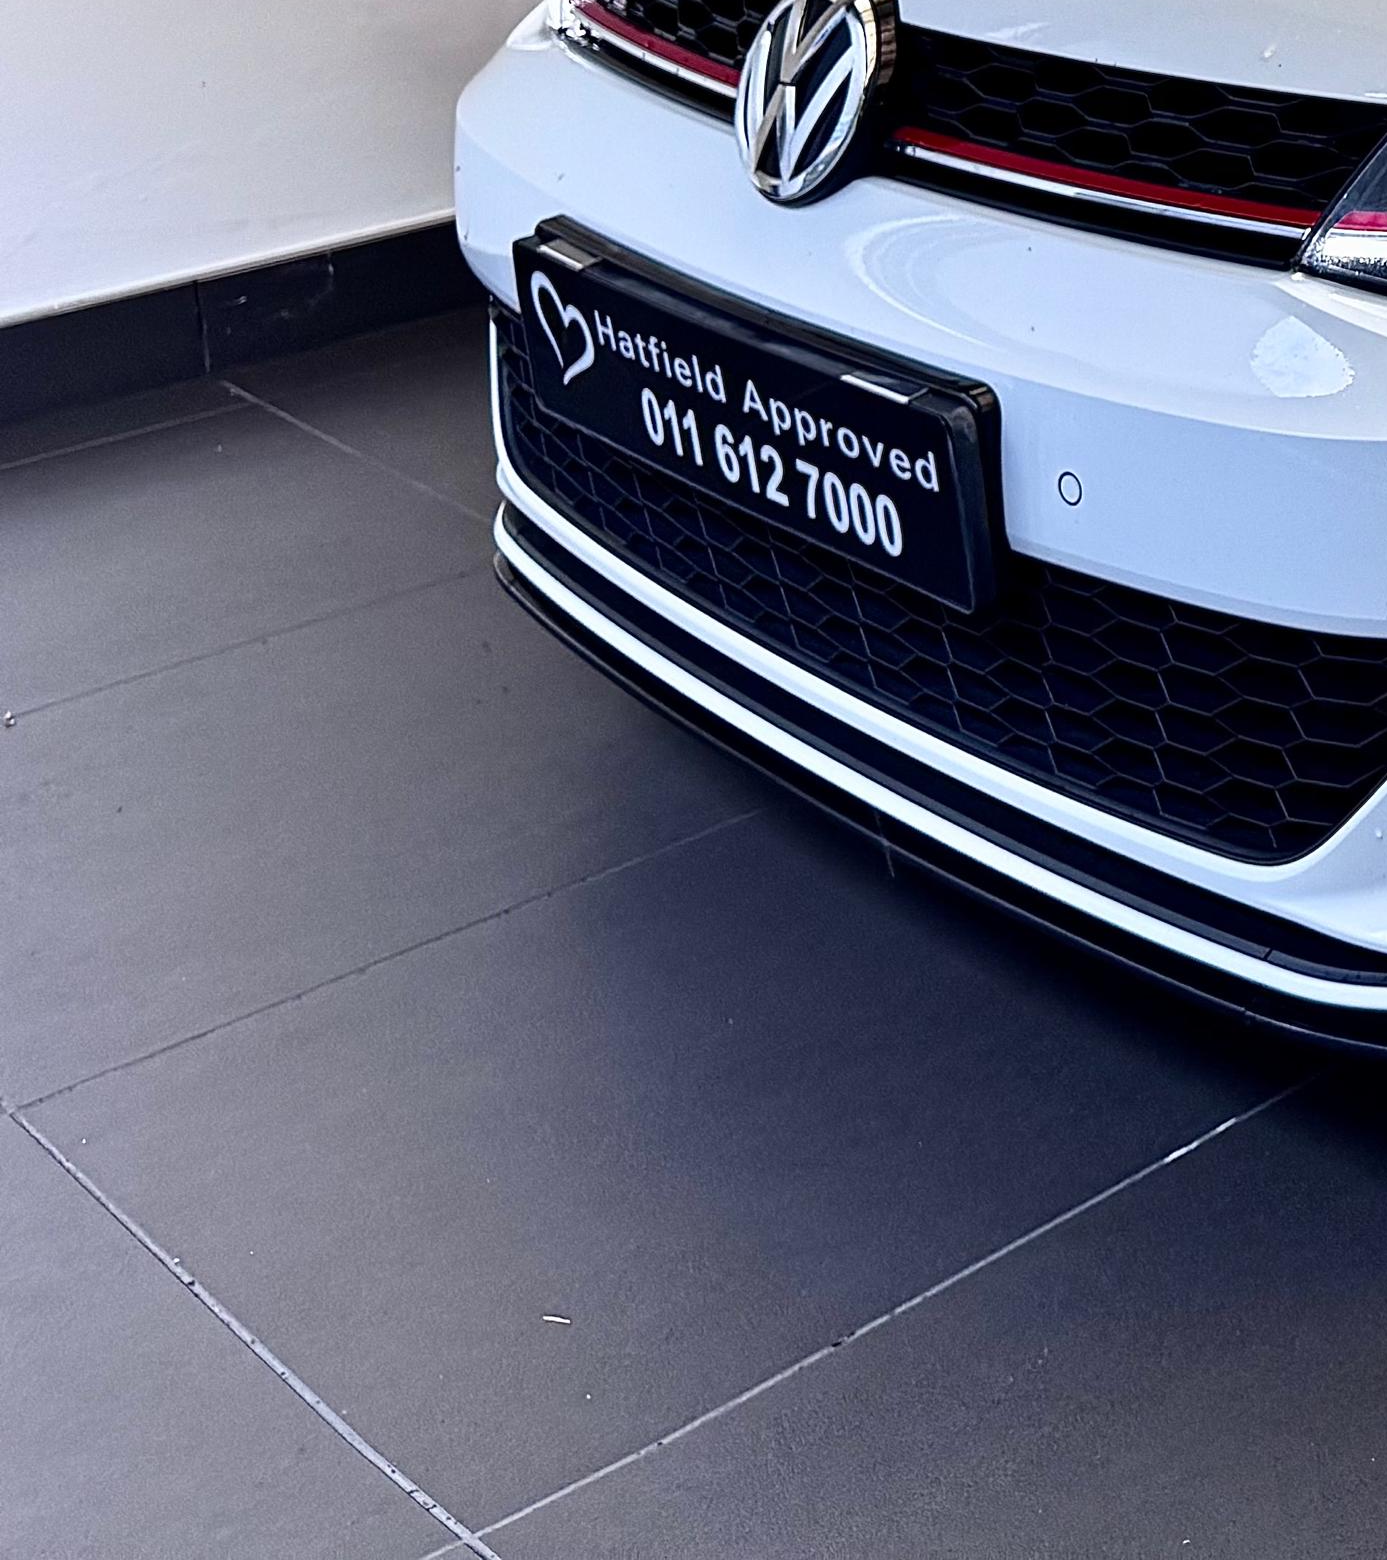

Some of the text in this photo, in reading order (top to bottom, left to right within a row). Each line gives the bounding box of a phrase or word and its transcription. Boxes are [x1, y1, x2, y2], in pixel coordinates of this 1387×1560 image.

[594, 310, 940, 492] Hatfield Approved
[641, 387, 903, 557] 011 612 7000
